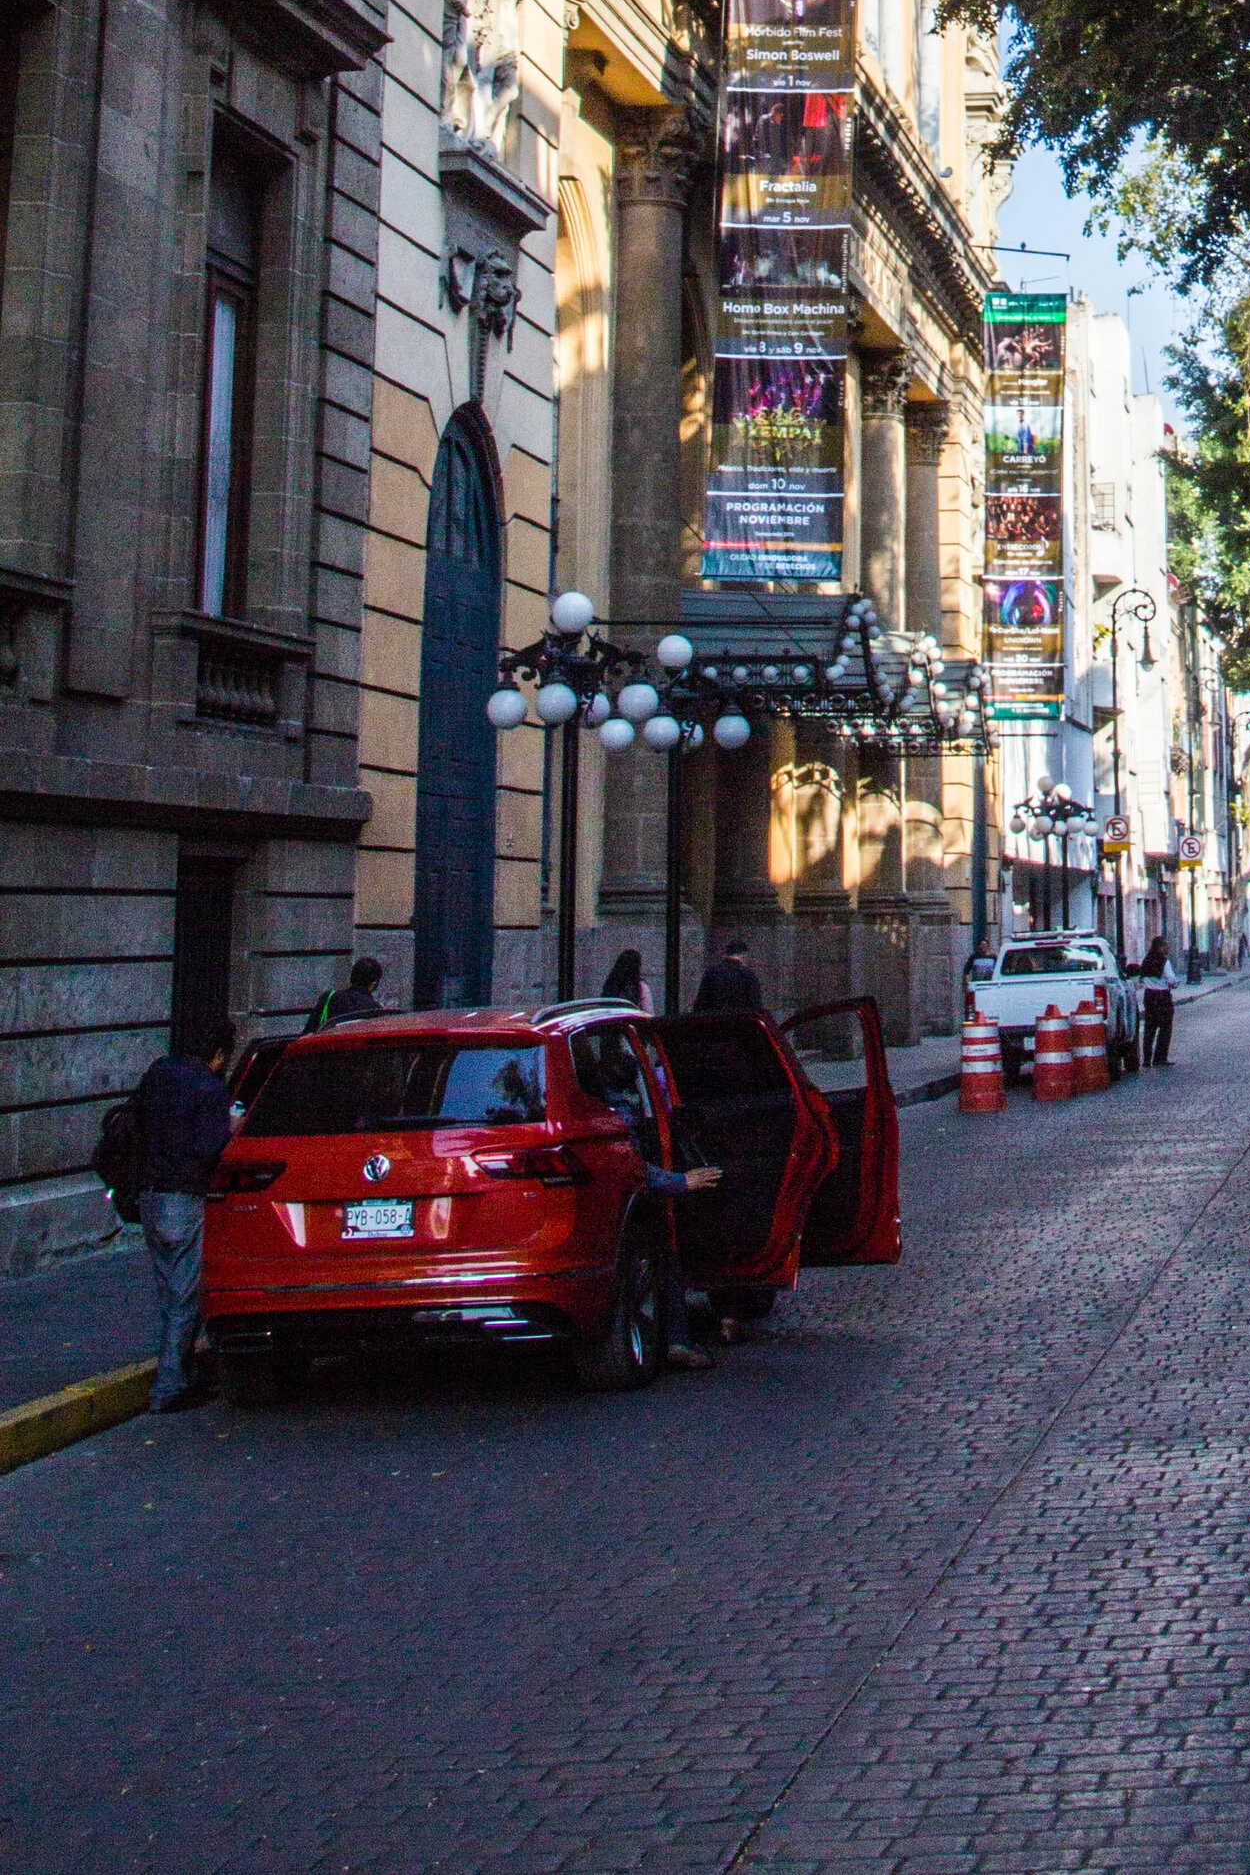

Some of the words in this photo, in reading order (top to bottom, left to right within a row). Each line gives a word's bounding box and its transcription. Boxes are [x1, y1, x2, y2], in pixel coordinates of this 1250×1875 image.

[794, 26, 816, 38] Film
[818, 27, 843, 38] Fest
[746, 48, 787, 61] Simon
[791, 49, 840, 62] Boswell
[787, 74, 794, 87] 1
[795, 79, 812, 88] nov
[759, 179, 818, 193] Fractalia
[763, 215, 780, 224] mar
[782, 211, 792, 224] 5
[794, 215, 810, 224] nov
[722, 301, 761, 314] Homo
[763, 302, 789, 315] Box
[792, 303, 845, 316] Machina
[793, 342, 803, 355] 9
[1003, 454, 1047, 465] CARREYÓ
[748, 482, 769, 490] dom
[771, 478, 787, 491] 10
[788, 482, 806, 491] nov
[726, 501, 825, 514] PROGRAMACIÓN
[739, 514, 811, 526] NOVIEMBRE
